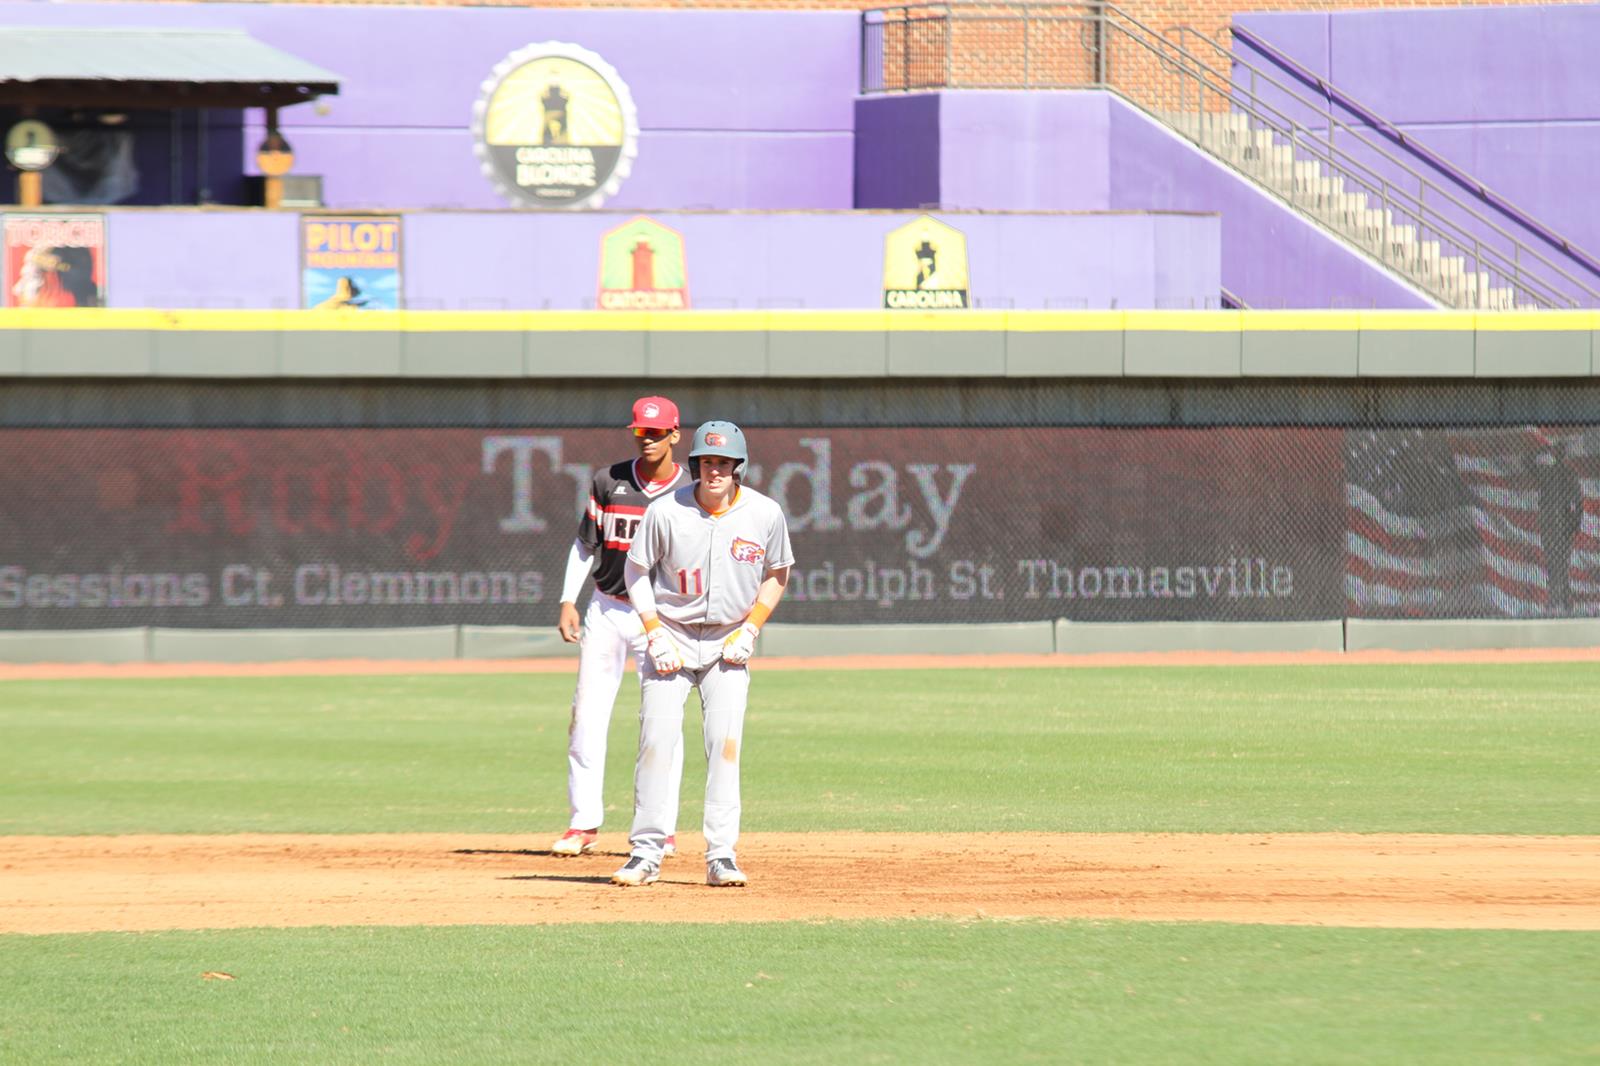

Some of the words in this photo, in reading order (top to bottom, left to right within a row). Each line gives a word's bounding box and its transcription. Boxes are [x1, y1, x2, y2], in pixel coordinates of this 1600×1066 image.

[516, 164, 596, 186] BLONDE
[307, 223, 399, 251] PILOT
[887, 290, 963, 308] CAROLINA
[166, 434, 479, 561] Ruby
[482, 435, 976, 558] Tday
[0, 563, 208, 607] Sessions
[221, 564, 284, 606] Ct.
[294, 563, 544, 605] Clemmons
[678, 568, 703, 595] 11
[783, 560, 937, 608] ndolph
[948, 560, 1004, 600] St.
[1017, 558, 1294, 600] Thomasville
